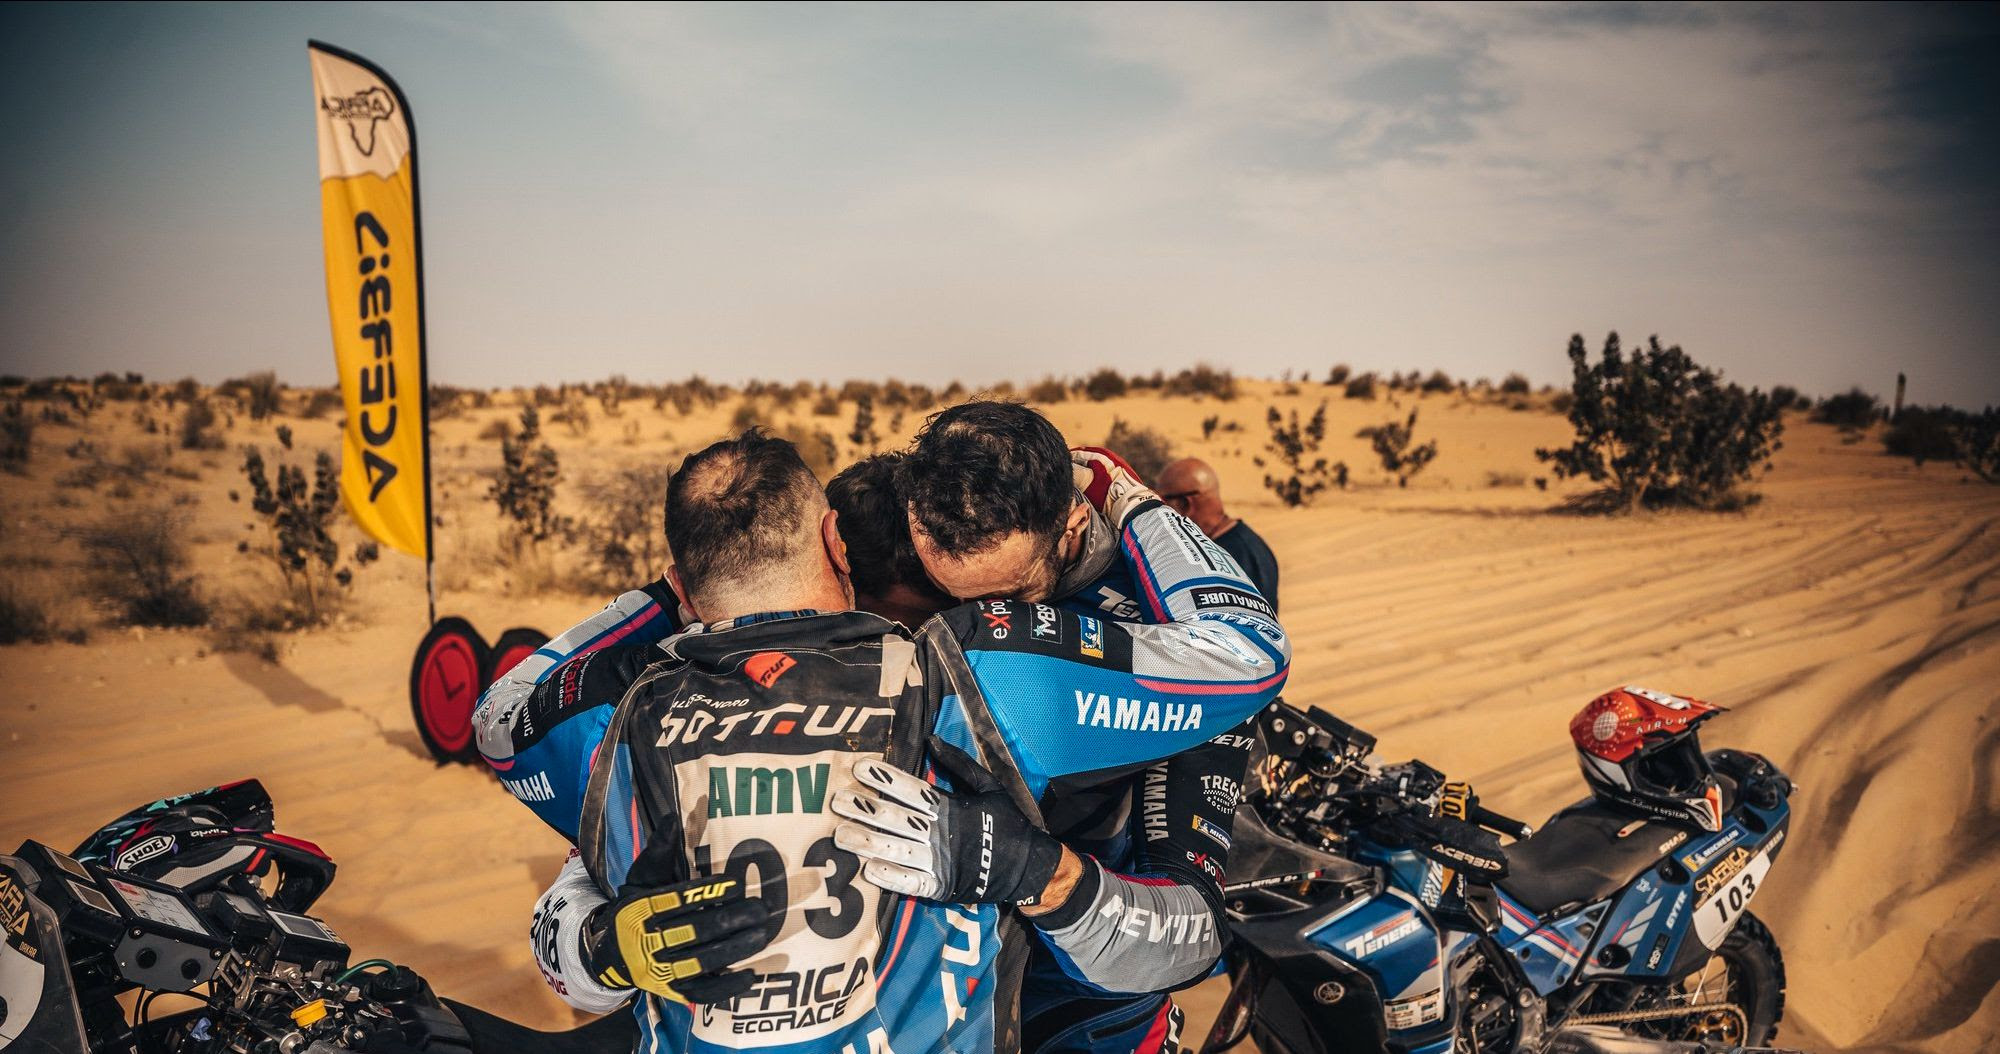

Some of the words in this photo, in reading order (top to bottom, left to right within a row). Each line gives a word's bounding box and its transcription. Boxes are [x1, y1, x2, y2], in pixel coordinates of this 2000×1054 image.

[1198, 592, 1275, 619] YAMALUBE
[1074, 690, 1204, 732] YAMAHA
[1143, 760, 1170, 842] YAMAHA
[1200, 775, 1240, 806] TRECE
[122, 837, 168, 867] SHOEI
[979, 811, 995, 898] SCOTT
[1432, 844, 1502, 871] ACERBIS
[1704, 846, 1751, 895] AFRICA
[1714, 873, 1756, 923] 103
[731, 956, 869, 1014] FRICA
